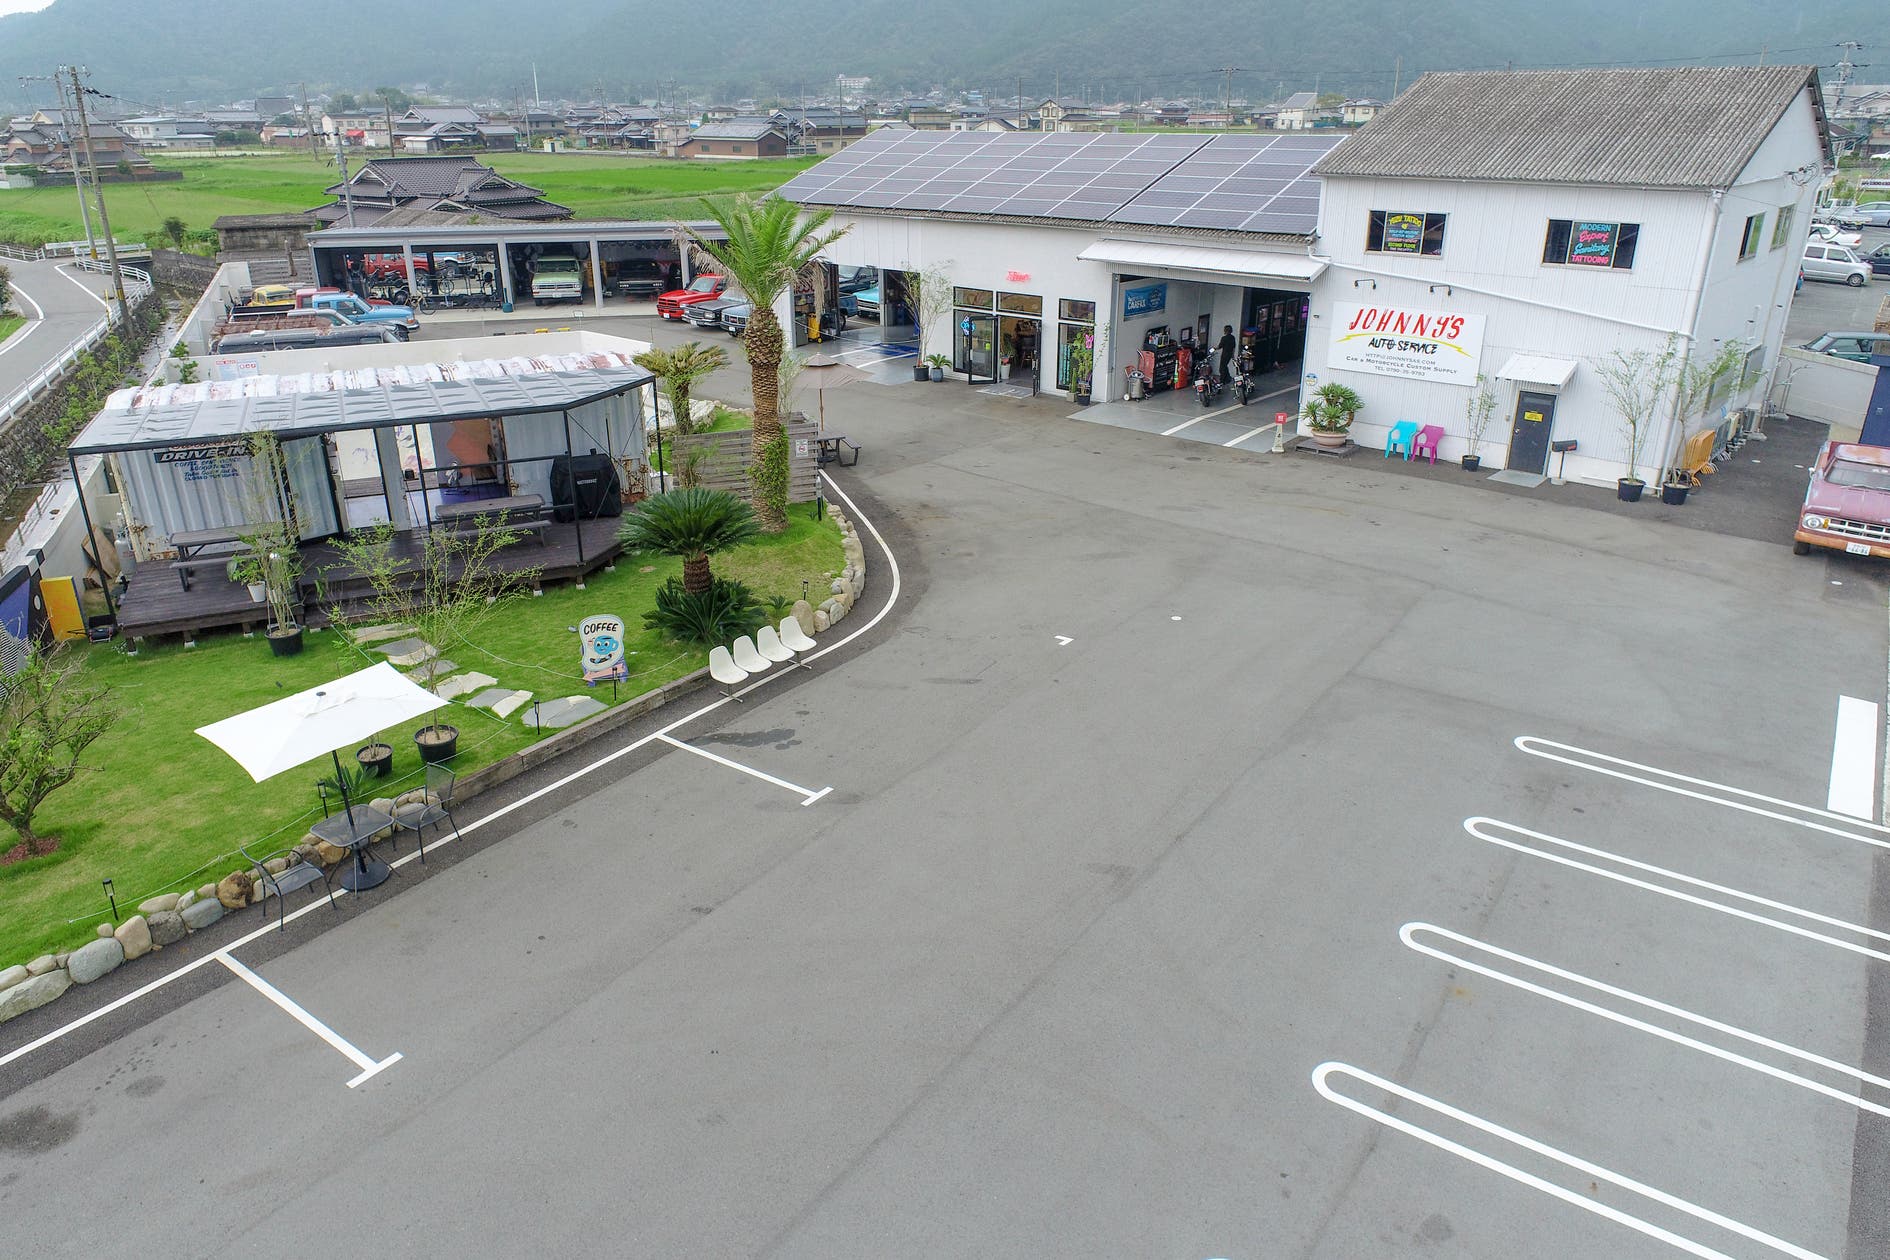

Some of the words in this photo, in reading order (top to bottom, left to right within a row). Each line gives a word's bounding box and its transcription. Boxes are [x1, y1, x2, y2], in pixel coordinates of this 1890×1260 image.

[1580, 223, 1611, 232] MODERN
[1580, 230, 1608, 242] Expert
[1571, 254, 1609, 264] TATTOOING
[1349, 308, 1465, 340] JOHNNY'S
[1368, 338, 1396, 350] AUTO
[1397, 340, 1439, 355] SERVICE
[1406, 362, 1431, 371] CUSTOM
[1433, 366, 1458, 374] SUPPLY
[583, 622, 618, 635] COFFEE
